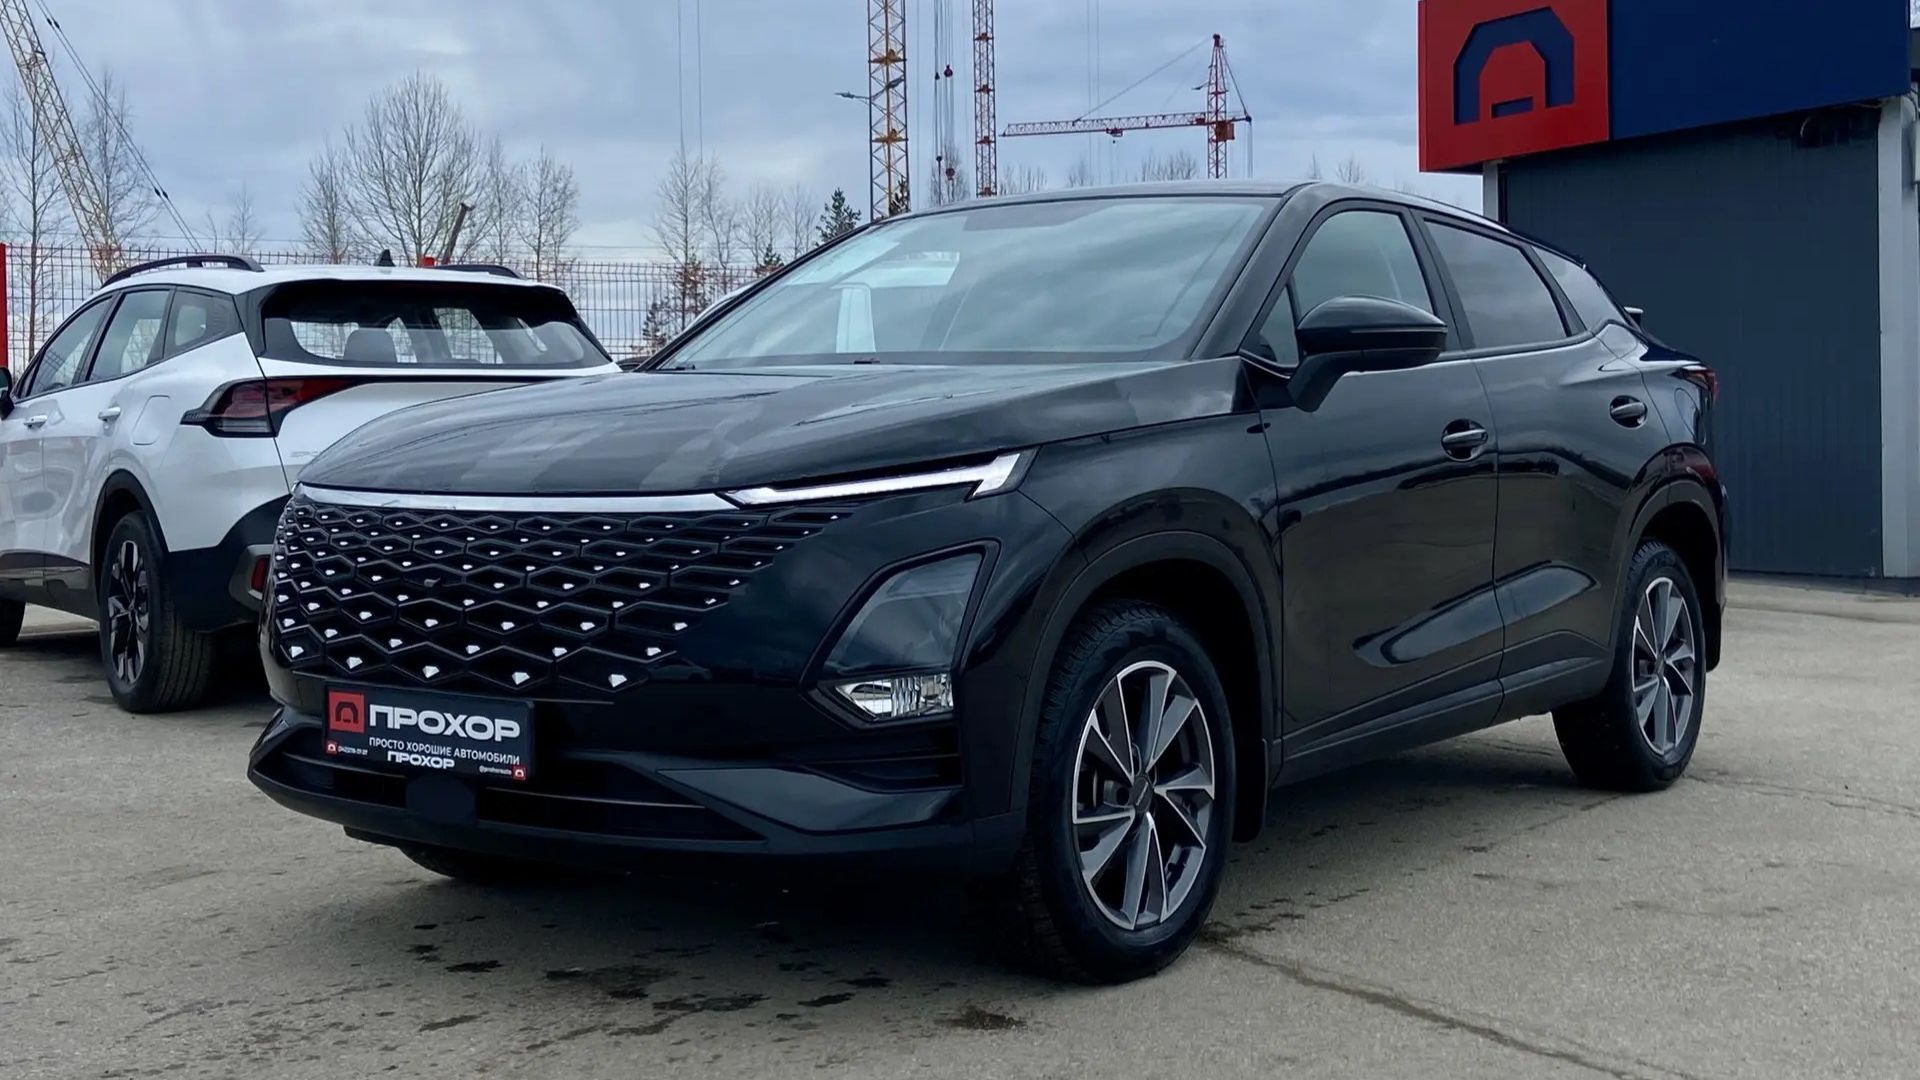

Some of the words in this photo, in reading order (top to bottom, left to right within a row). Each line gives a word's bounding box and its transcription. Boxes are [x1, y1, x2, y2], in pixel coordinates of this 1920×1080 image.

[369, 704, 521, 742] ПРОХОР
[369, 737, 405, 751] ПРОСТО
[406, 742, 452, 757] ХОРОШИЕ
[453, 748, 520, 766] АВТОМОБИЛИ
[387, 751, 455, 770] ПРОХОР
